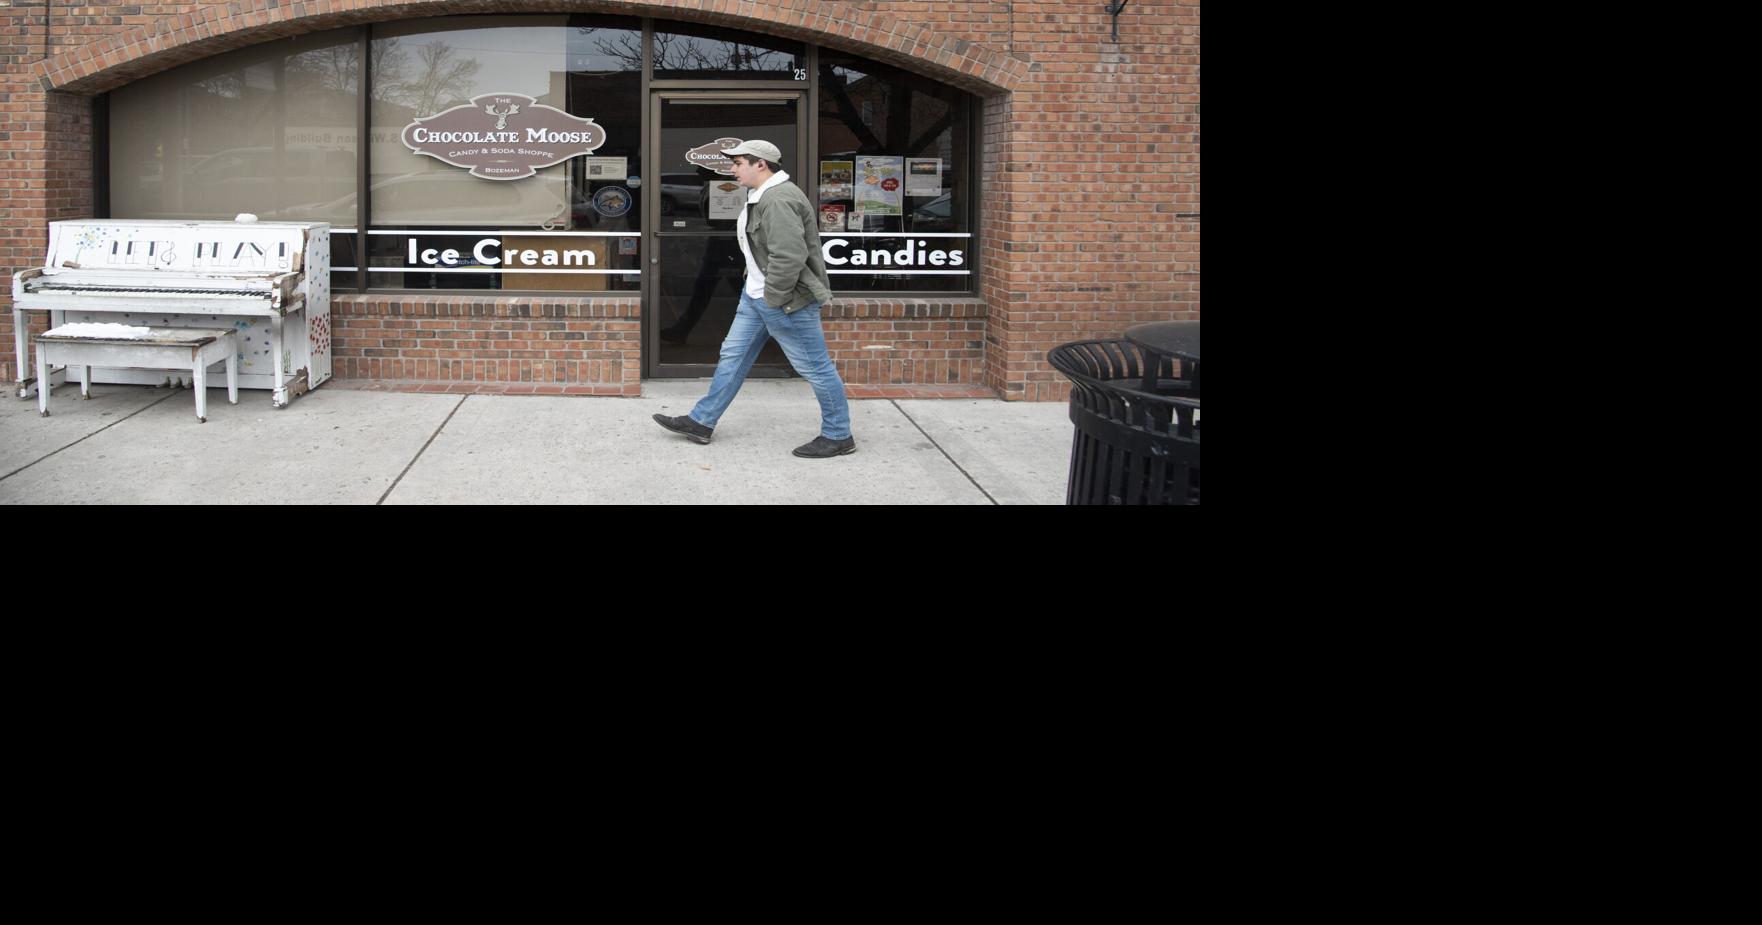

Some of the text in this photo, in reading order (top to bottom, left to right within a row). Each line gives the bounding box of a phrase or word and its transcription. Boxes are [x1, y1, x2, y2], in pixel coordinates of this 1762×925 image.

[794, 68, 806, 81] 25
[413, 127, 592, 144] CHOCOLATE MOOSE
[448, 148, 479, 158] CANDY
[518, 148, 554, 159] SHOPPE
[690, 152, 731, 161] CHOCOLA
[192, 241, 290, 269] PLAY!
[408, 238, 596, 266] Ice Cream
[821, 238, 964, 266] Candies
